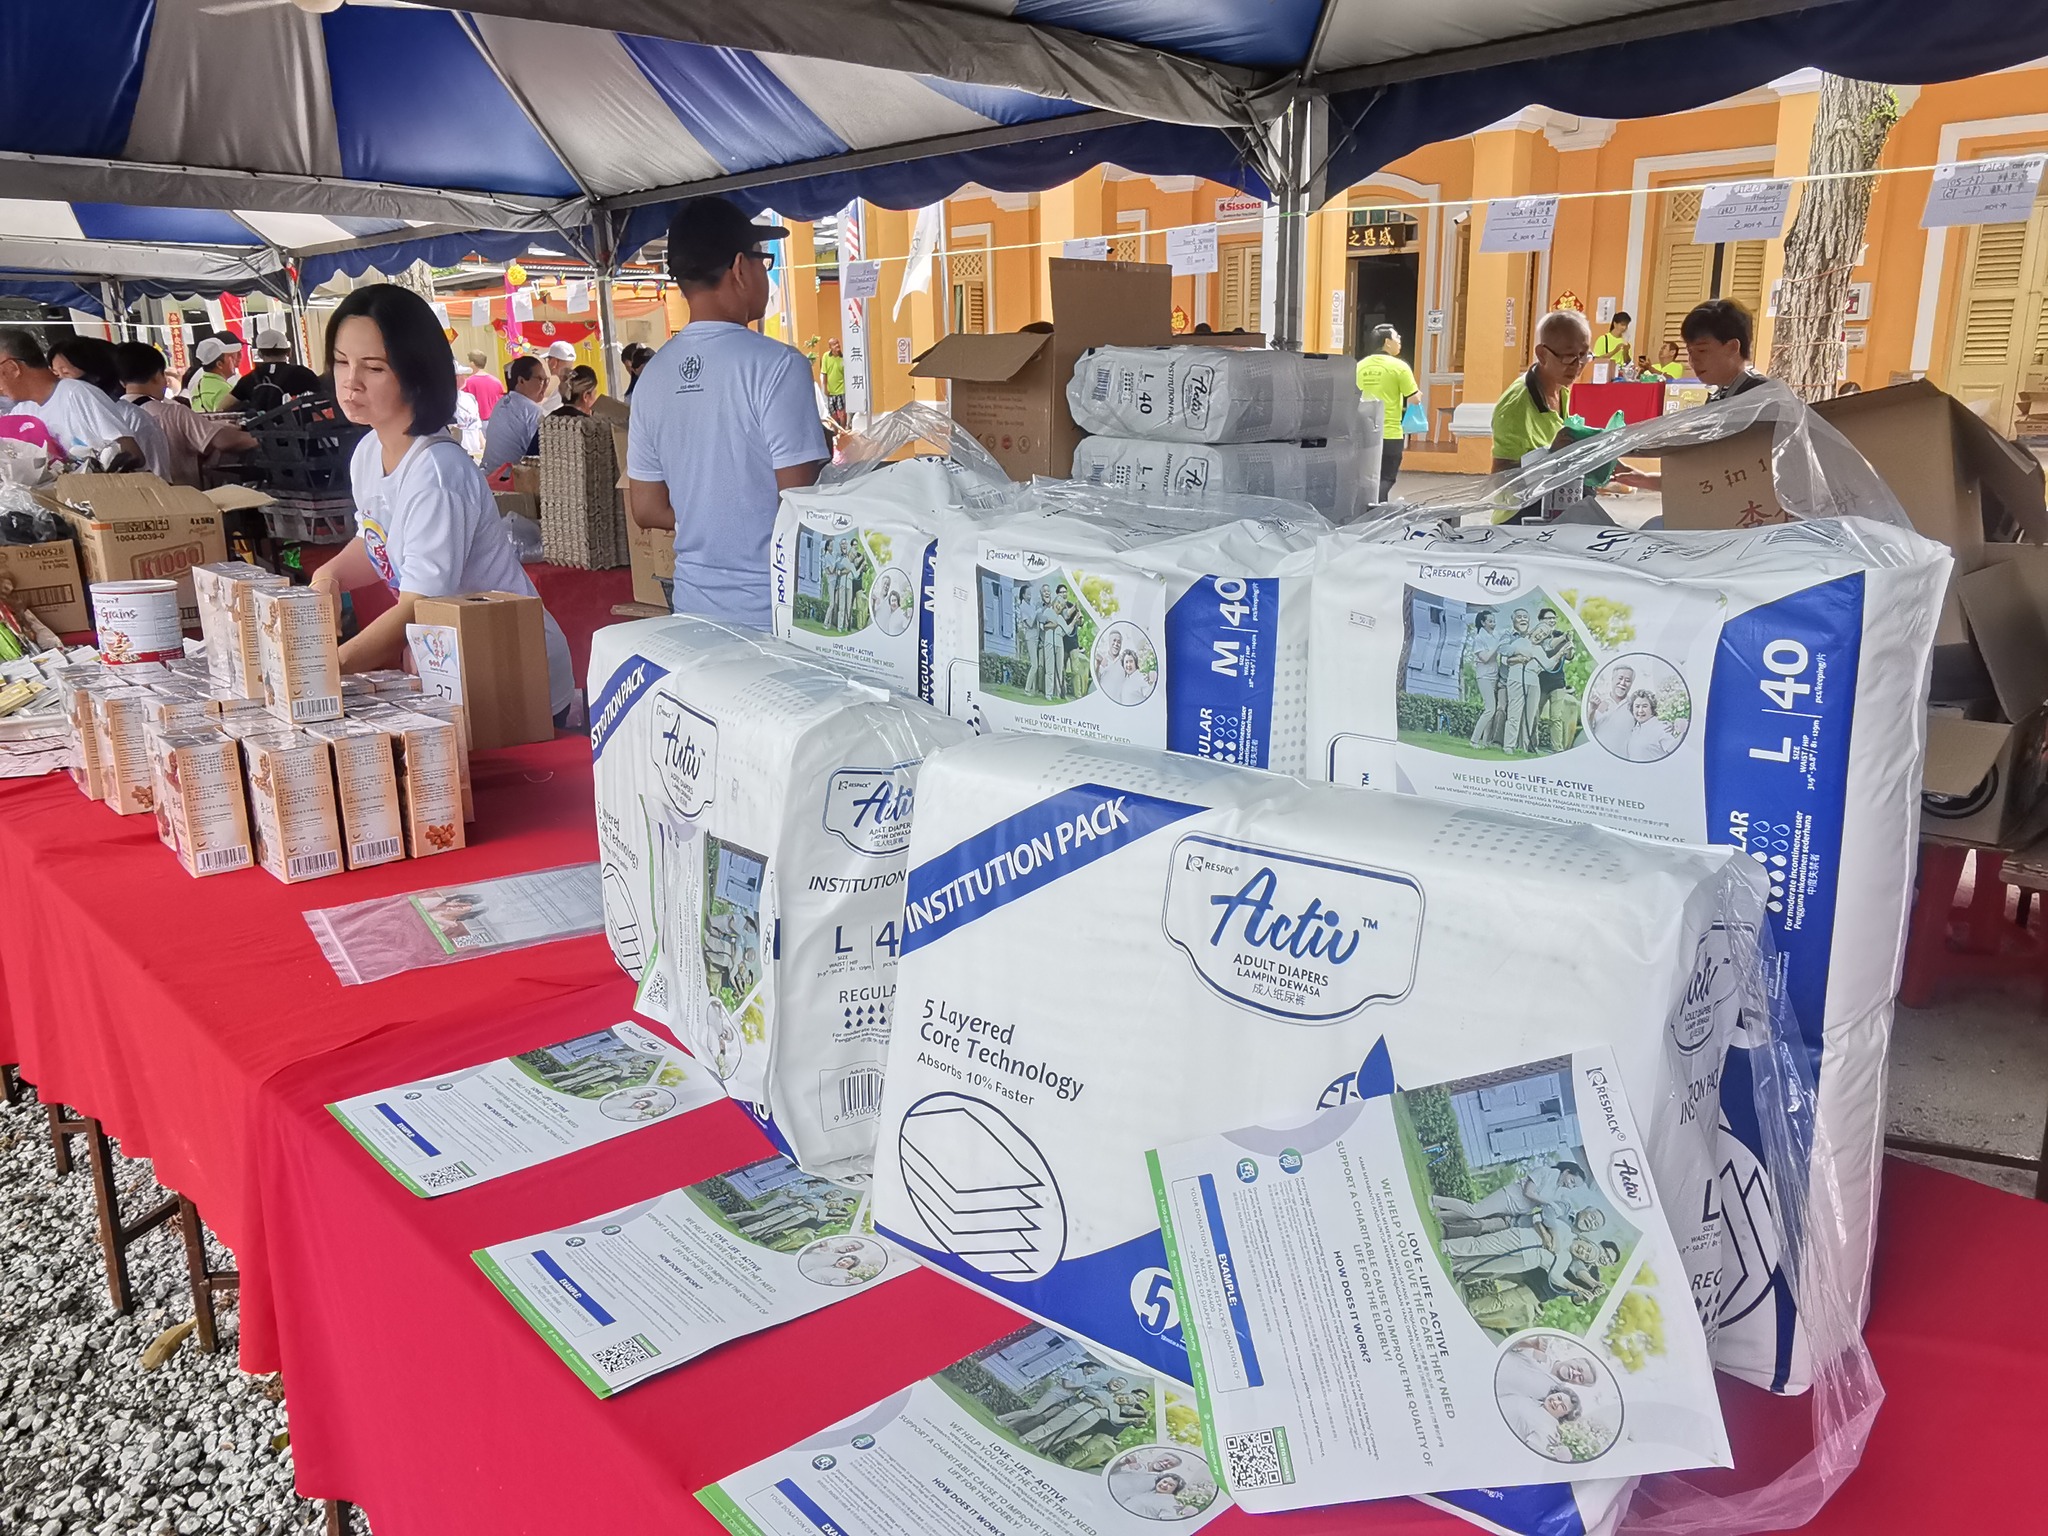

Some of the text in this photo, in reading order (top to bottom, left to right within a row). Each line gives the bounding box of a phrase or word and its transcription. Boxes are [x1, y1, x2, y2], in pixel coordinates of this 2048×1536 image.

[1226, 202, 1262, 211] Sissons
[1138, 373, 1154, 415] L 40
[1167, 361, 1176, 406] INSTITUTION
[1191, 376, 1209, 417] Activ
[1141, 466, 1153, 475] L
[1699, 458, 1767, 494] 3 in 1
[19, 548, 64, 559] 12040528
[115, 533, 165, 542] 1004-0039-0
[139, 546, 200, 579] K1000
[1027, 556, 1047, 567] Activ
[1484, 571, 1514, 587] Activ
[1211, 577, 1250, 677] M 40
[833, 642, 844, 650] LOVE
[858, 648, 874, 657] ACTIVE
[918, 639, 928, 701] REGULAR
[621, 663, 646, 699] PACK
[1749, 639, 1811, 763] L 40
[1040, 713, 1100, 731] LOVE LIFE ACTIVE
[1800, 734, 1810, 773] WAIST HIP
[1452, 772, 1645, 811] WE HELP YOU GIVE THE CARE THEY NEED
[1494, 769, 1594, 792] LOVE LIFE ACTIVE
[808, 869, 907, 893] INSTITUTION
[905, 796, 1130, 933] INSTITUTION PACK
[1785, 811, 1803, 931] For moderate Incontinence user
[1794, 815, 1812, 929] Pengguna inkontinen sederhana
[1807, 854, 1820, 895] 中度失禁者
[1210, 866, 1360, 965] Activ
[834, 921, 900, 957] L 4
[1233, 953, 1329, 987] ADULT DIAPERS
[1237, 967, 1321, 998] LAMPIN DEWASA
[1252, 983, 1306, 1007] 成人纸尿裤
[922, 998, 1016, 1046] 5 Layered
[916, 1051, 1035, 1105] Absorbs 10% Faster
[920, 1021, 1085, 1101] Core Technology
[1188, 1186, 1199, 1208] YOUR
[1612, 1157, 1646, 1204] Activ
[1701, 1178, 1720, 1223] L
[1192, 1207, 1208, 1247] DONATION
[1691, 1232, 1710, 1243] WAIST
[1197, 1256, 1216, 1313] RM200 RM400
[1204, 1258, 1217, 1284] RM200
[1216, 1251, 1238, 1307] EXAMPLE:
[1140, 1273, 1174, 1335] 5
[1192, 1263, 1203, 1288] PIECES
[1199, 1299, 1213, 1331] DIAPERS
[1332, 1249, 1372, 1365] HOW DOES IT WORK?
[1334, 1139, 1434, 1468] SUPPORT A CHARITABLE CAUSE TO IMPROVE THE QUALITY OF
[1351, 1243, 1393, 1362] LIFE FOR THE ELDERLY!
[1379, 1177, 1456, 1419] WE HELP YOU GIVE THE CARE THEY NEED
[1405, 1230, 1449, 1357] LOVE LIFE ACTIVE
[1221, 1328, 1239, 1369] DONATION
[1232, 1369, 1241, 1381] OF
[986, 1442, 1069, 1503] LOVE LIFE ACTIVE
[930, 1477, 979, 1516] HOW DOES IT
